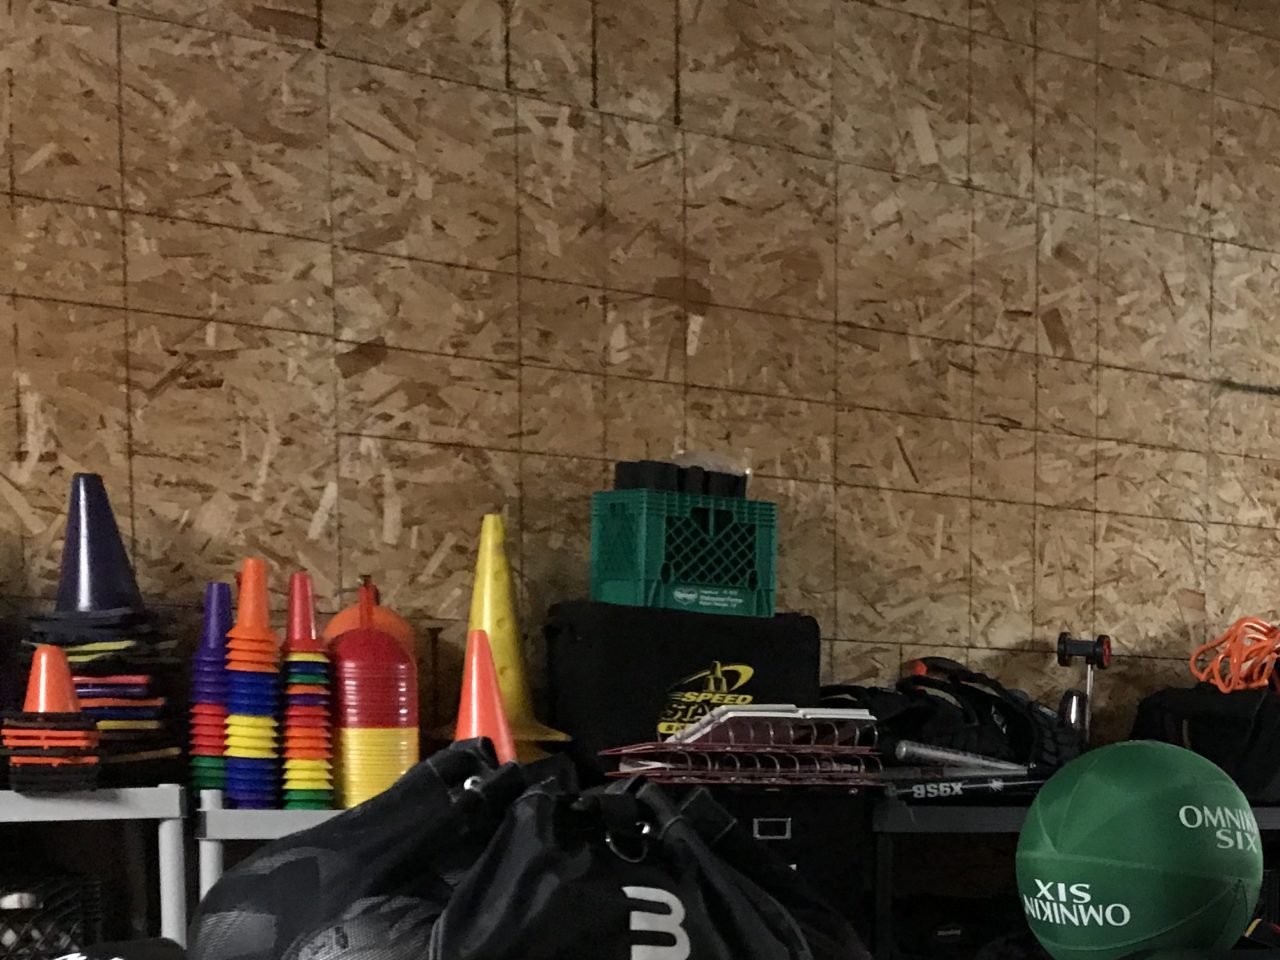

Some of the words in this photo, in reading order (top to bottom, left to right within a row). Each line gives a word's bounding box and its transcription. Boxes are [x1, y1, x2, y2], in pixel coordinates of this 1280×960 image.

[680, 691, 753, 705] SPEED
[1215, 829, 1257, 853] SIX
[1034, 878, 1092, 904] SIX
[1023, 894, 1131, 926] OMNIKIN
